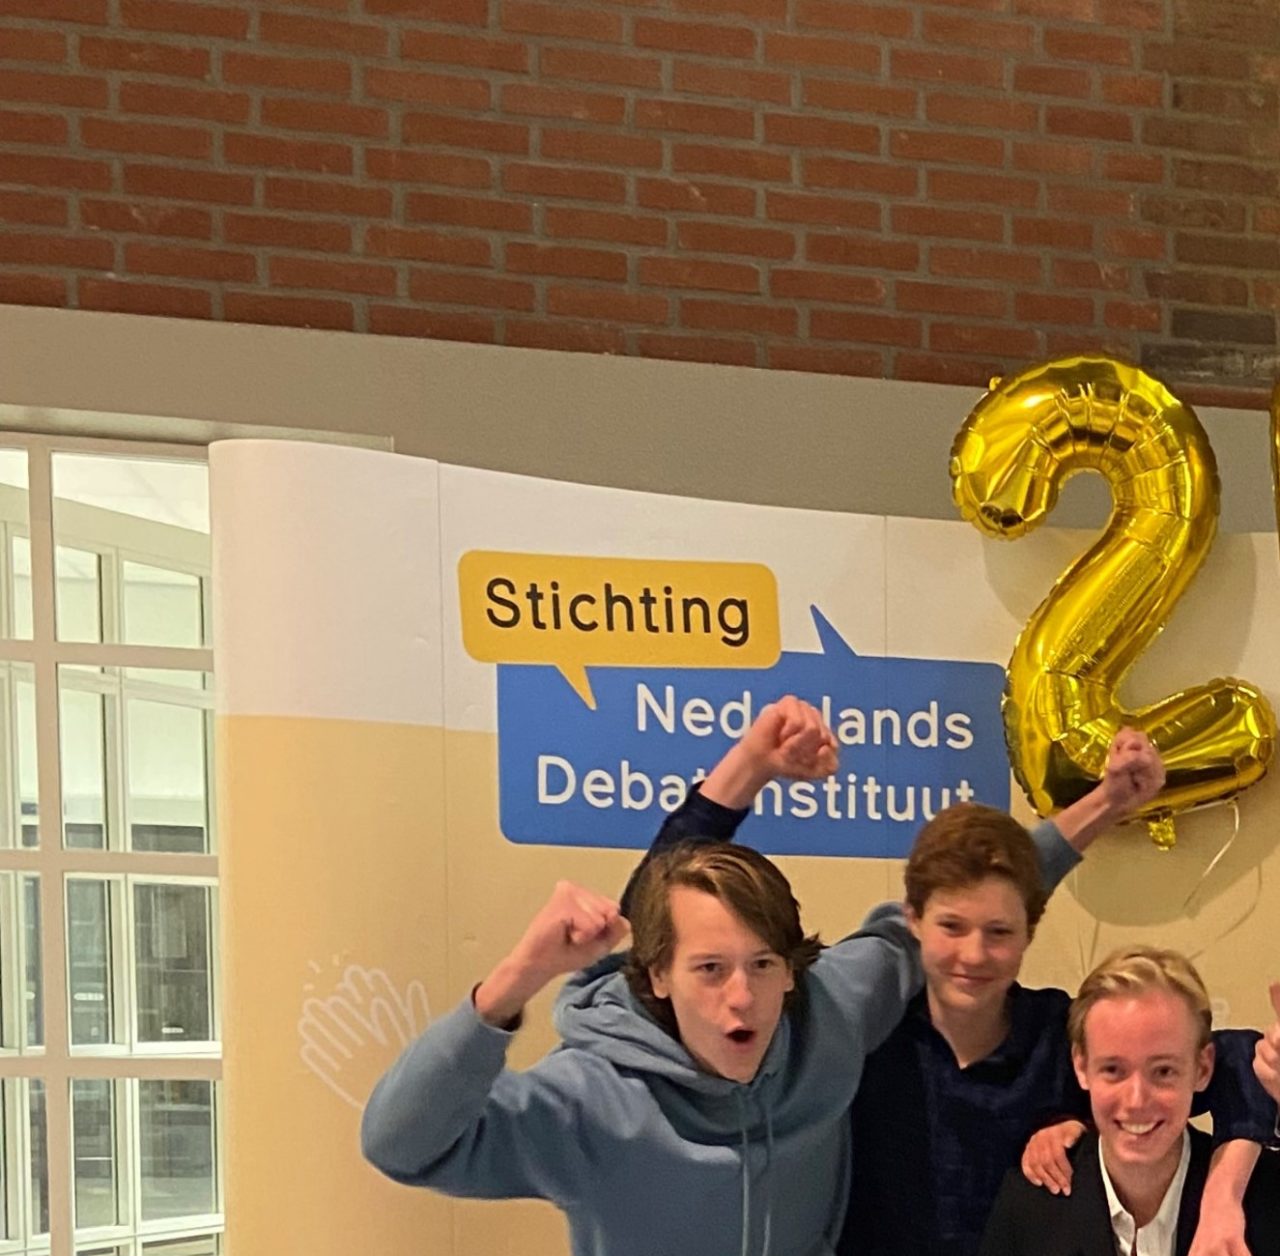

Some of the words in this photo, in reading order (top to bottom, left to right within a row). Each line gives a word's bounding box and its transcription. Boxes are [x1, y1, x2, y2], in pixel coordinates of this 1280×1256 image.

[485, 577, 750, 647] Stichting
[636, 683, 974, 750] Nedlands
[537, 755, 974, 822] Debanstituut
